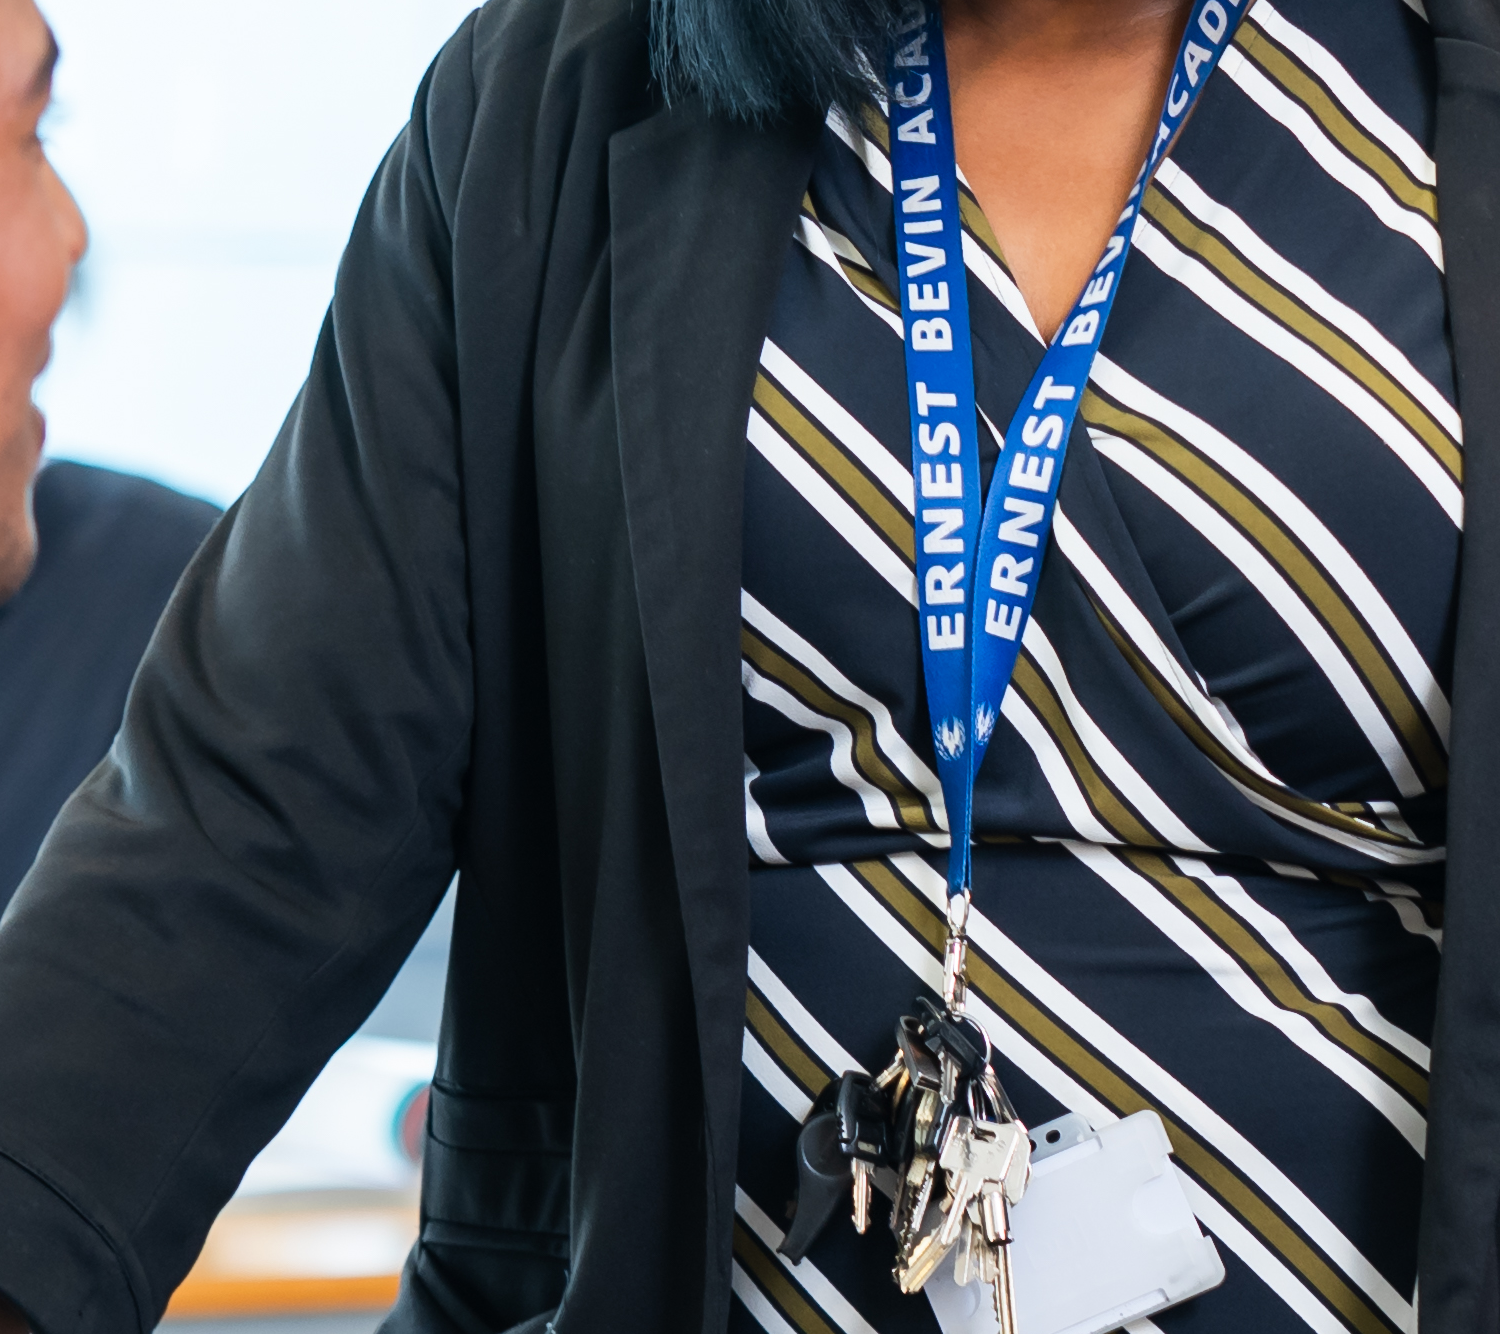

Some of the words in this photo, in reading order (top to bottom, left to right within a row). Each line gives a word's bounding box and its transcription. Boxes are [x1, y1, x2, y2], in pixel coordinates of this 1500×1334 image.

[901, 175, 953, 352] BEVIN
[915, 380, 966, 651] ERNEST
[985, 375, 1077, 641] ERNEST
